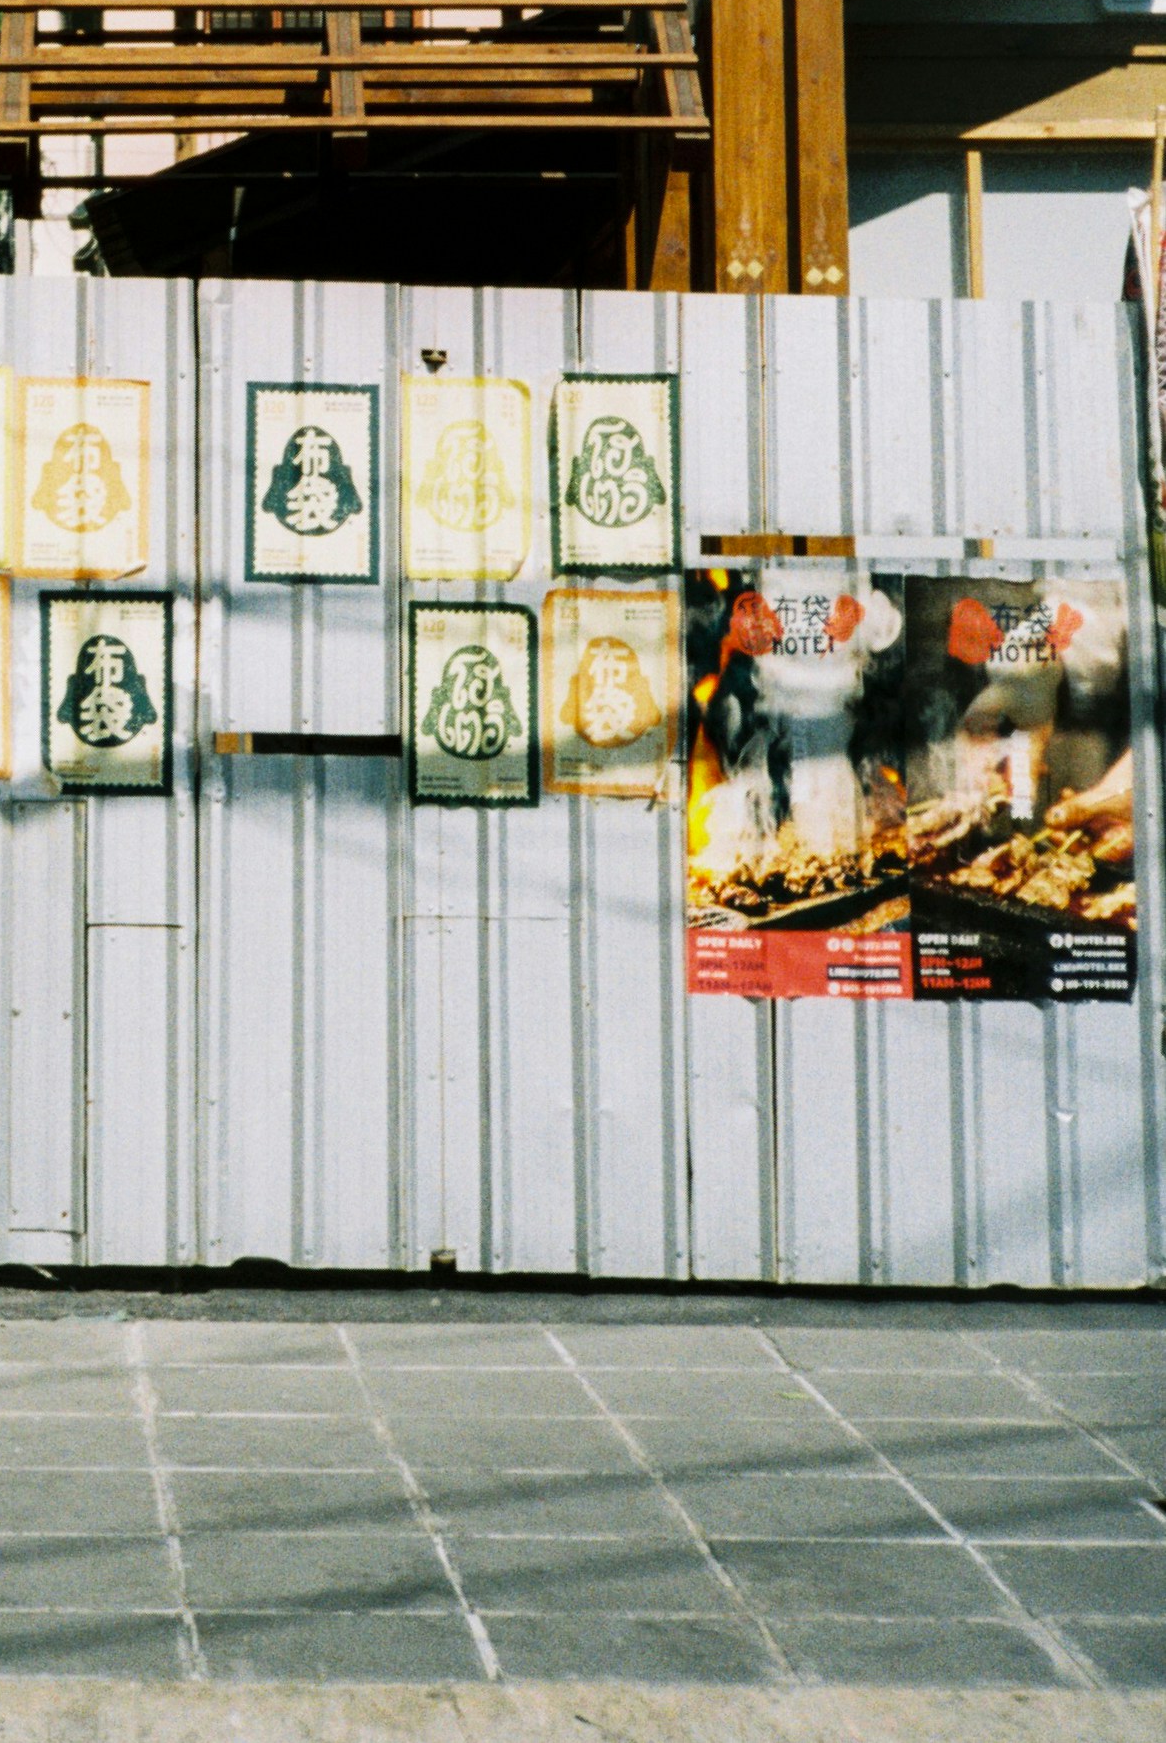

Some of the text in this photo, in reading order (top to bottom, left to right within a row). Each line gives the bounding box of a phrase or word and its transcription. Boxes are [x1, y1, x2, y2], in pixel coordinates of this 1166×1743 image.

[56, 429, 106, 526] 布袋
[286, 428, 339, 531] 布袋
[774, 595, 832, 626] 布袋
[991, 603, 1054, 633] 布袋
[80, 639, 133, 741] 布袋
[585, 641, 636, 741] 布袋
